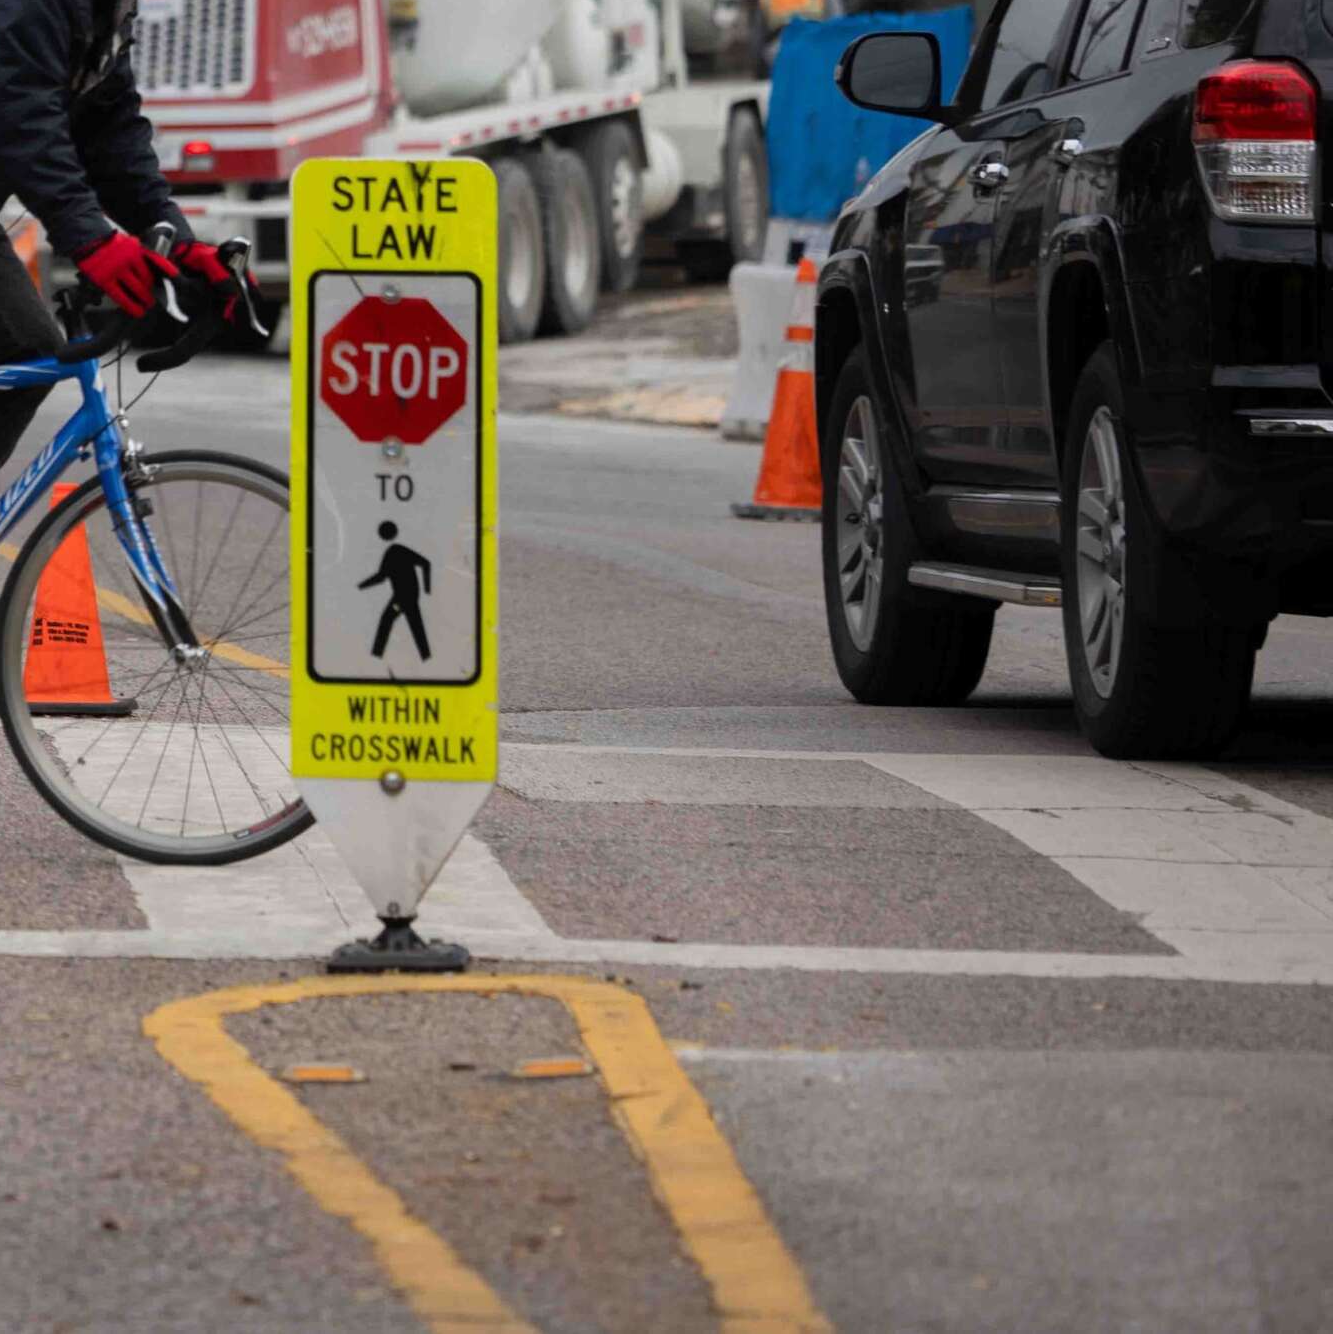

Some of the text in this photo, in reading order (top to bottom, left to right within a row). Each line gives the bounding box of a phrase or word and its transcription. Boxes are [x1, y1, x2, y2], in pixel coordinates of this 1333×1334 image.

[351, 224, 436, 260] LAW
[329, 342, 460, 399] STOP
[375, 474, 413, 501] TO
[347, 697, 440, 724] WITHIN
[310, 733, 476, 764] CROSSWALK
